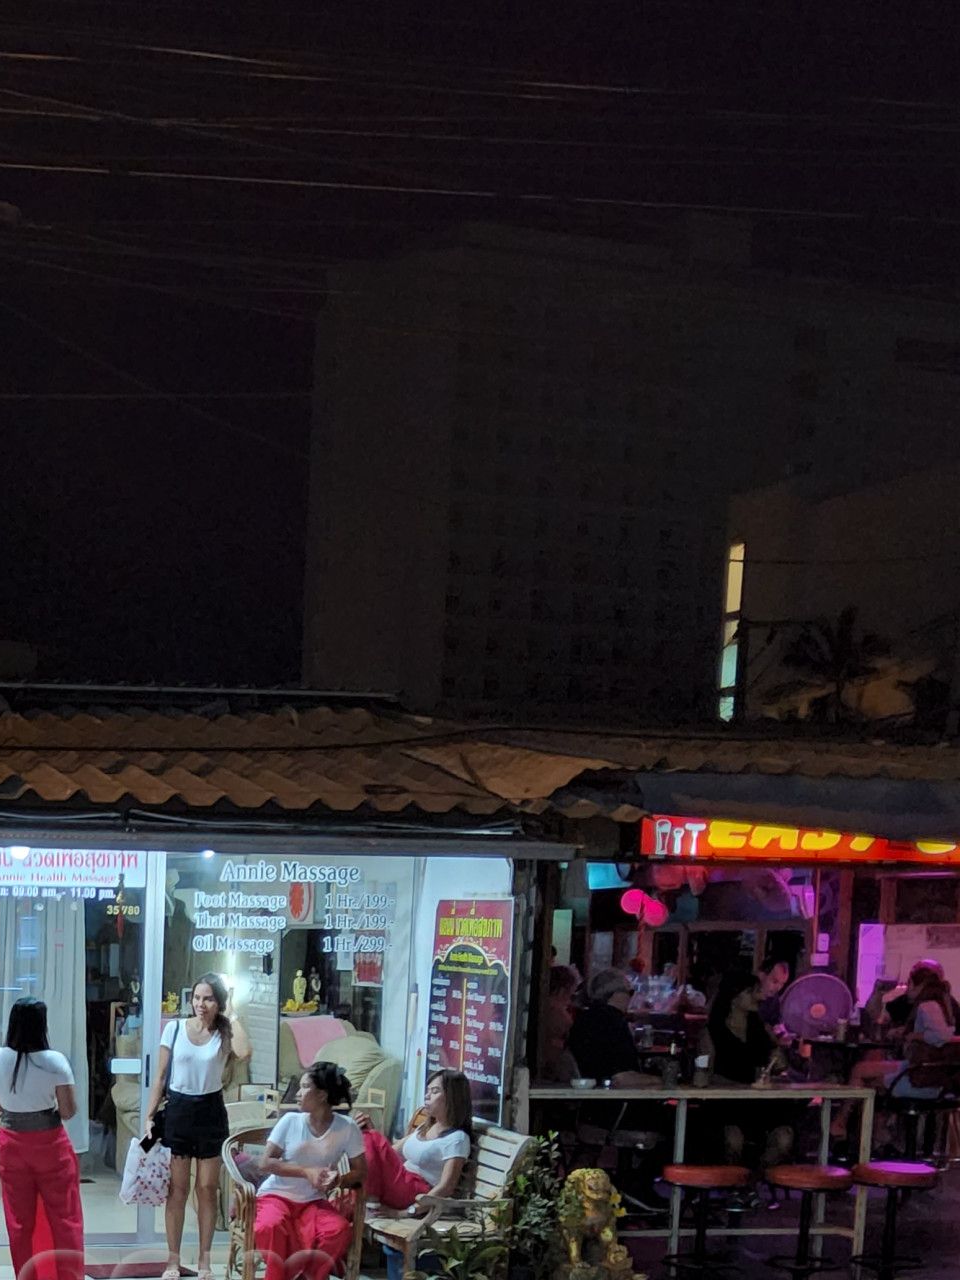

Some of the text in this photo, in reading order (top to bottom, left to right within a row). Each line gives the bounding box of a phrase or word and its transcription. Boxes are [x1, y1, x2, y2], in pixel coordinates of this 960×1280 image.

[31, 871, 67, 882] Health
[220, 860, 360, 887] Annie Massage
[194, 891, 226, 908] Foot
[228, 892, 287, 911] Massage
[195, 911, 225, 929] Thai
[228, 913, 287, 932] Massage
[193, 934, 214, 951] Oil
[215, 935, 274, 955] Massage
